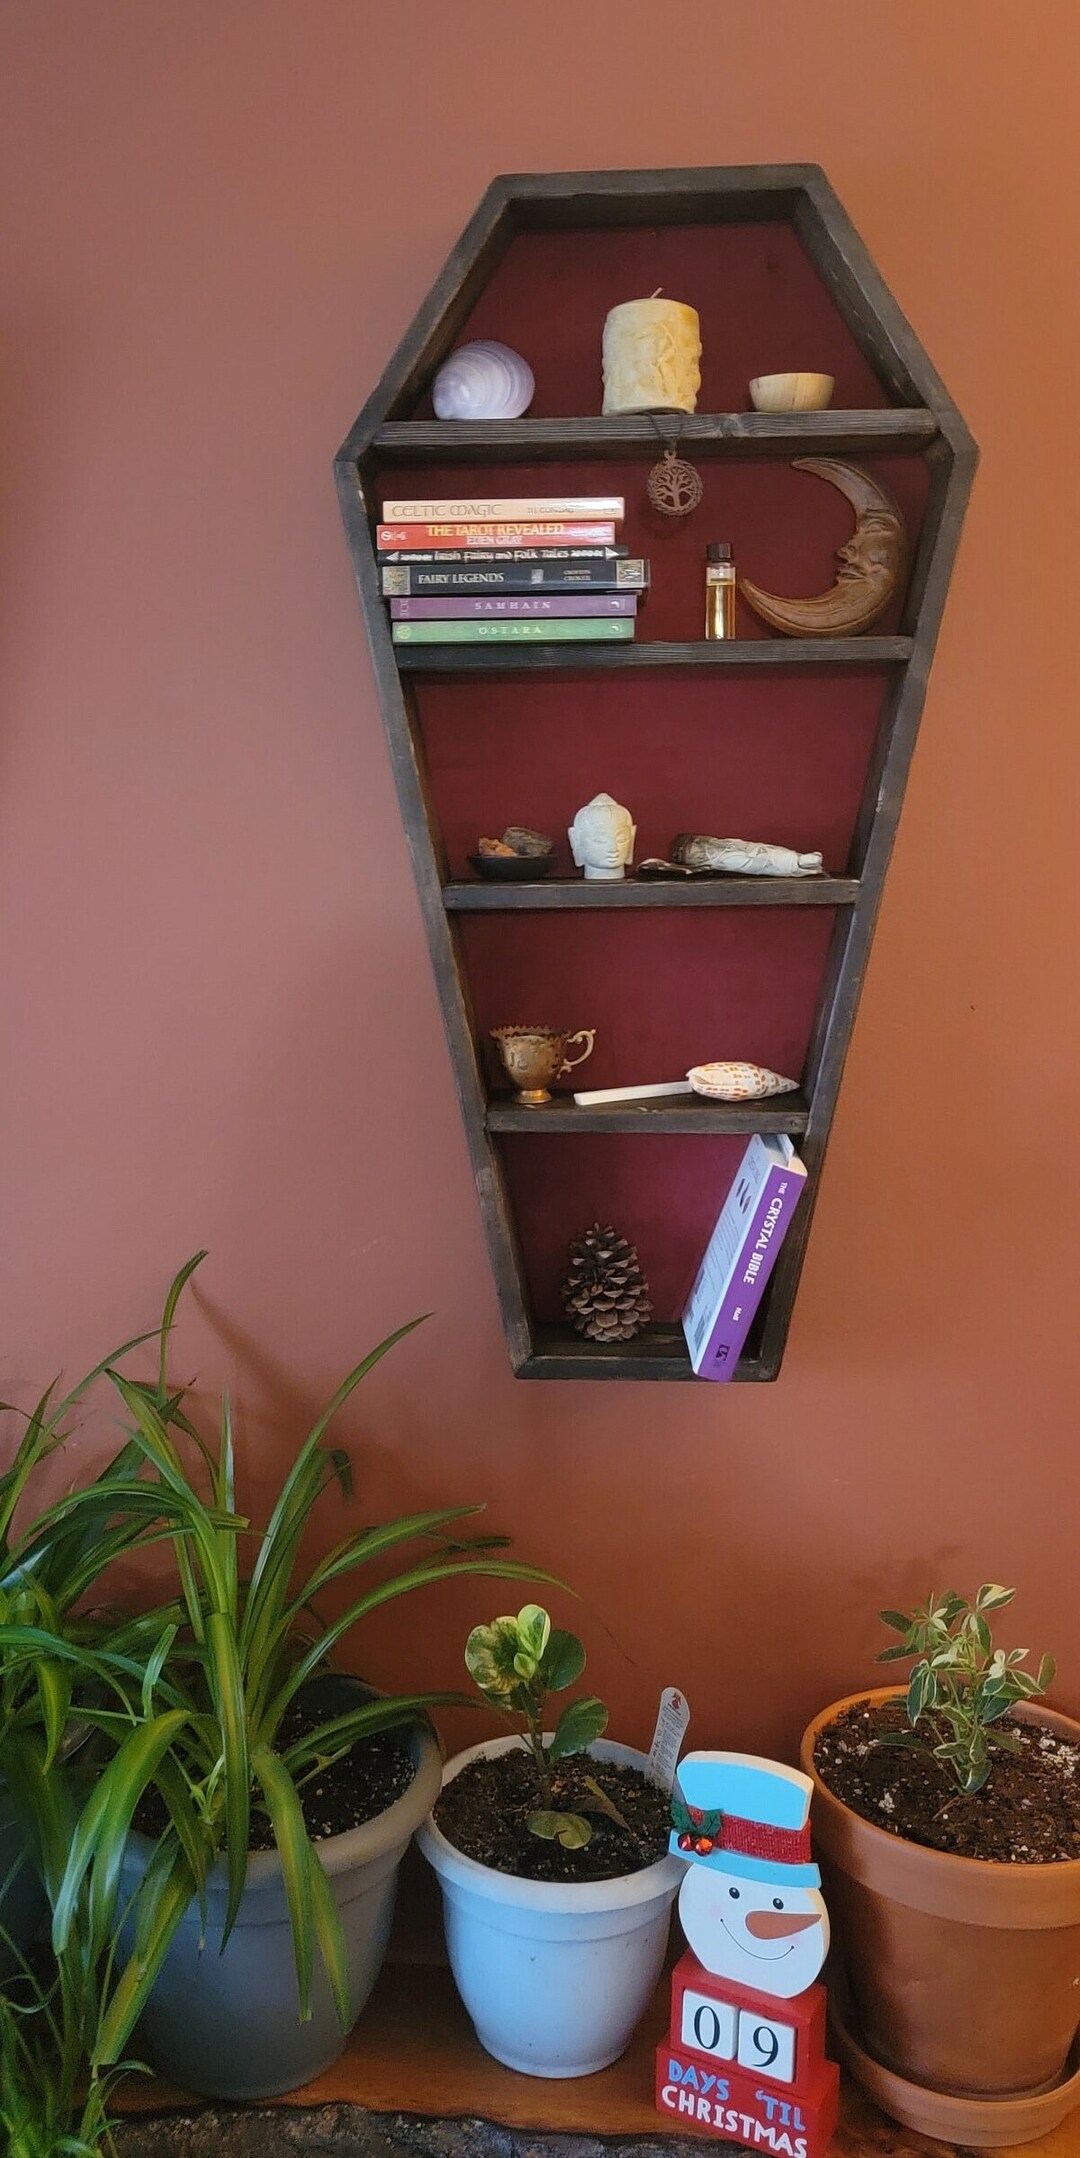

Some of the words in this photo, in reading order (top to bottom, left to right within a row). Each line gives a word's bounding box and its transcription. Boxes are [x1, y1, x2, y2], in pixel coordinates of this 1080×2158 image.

[391, 504, 446, 516] CELTIC
[449, 504, 502, 517] MAGIC
[426, 525, 453, 536] THE
[456, 524, 493, 536] TAROT
[497, 523, 564, 535] REVEALED
[466, 536, 494, 545] EDEN
[496, 535, 522, 544] GRAY
[435, 550, 461, 561] Irish
[464, 550, 494, 563] Fairy
[514, 549, 538, 561] Folk
[540, 549, 569, 559] Tales
[418, 574, 452, 584] FAIRY
[453, 572, 505, 583] LEGENDS
[474, 601, 552, 610] SAMHAIN
[478, 626, 542, 635] OSTARA
[778, 1182, 788, 1195] THE
[755, 1198, 783, 1250] CRYSTAL
[743, 1252, 764, 1286] BIBLE
[668, 2058, 730, 2101] DAYS
[661, 2085, 808, 2158] CHRISTMAS
